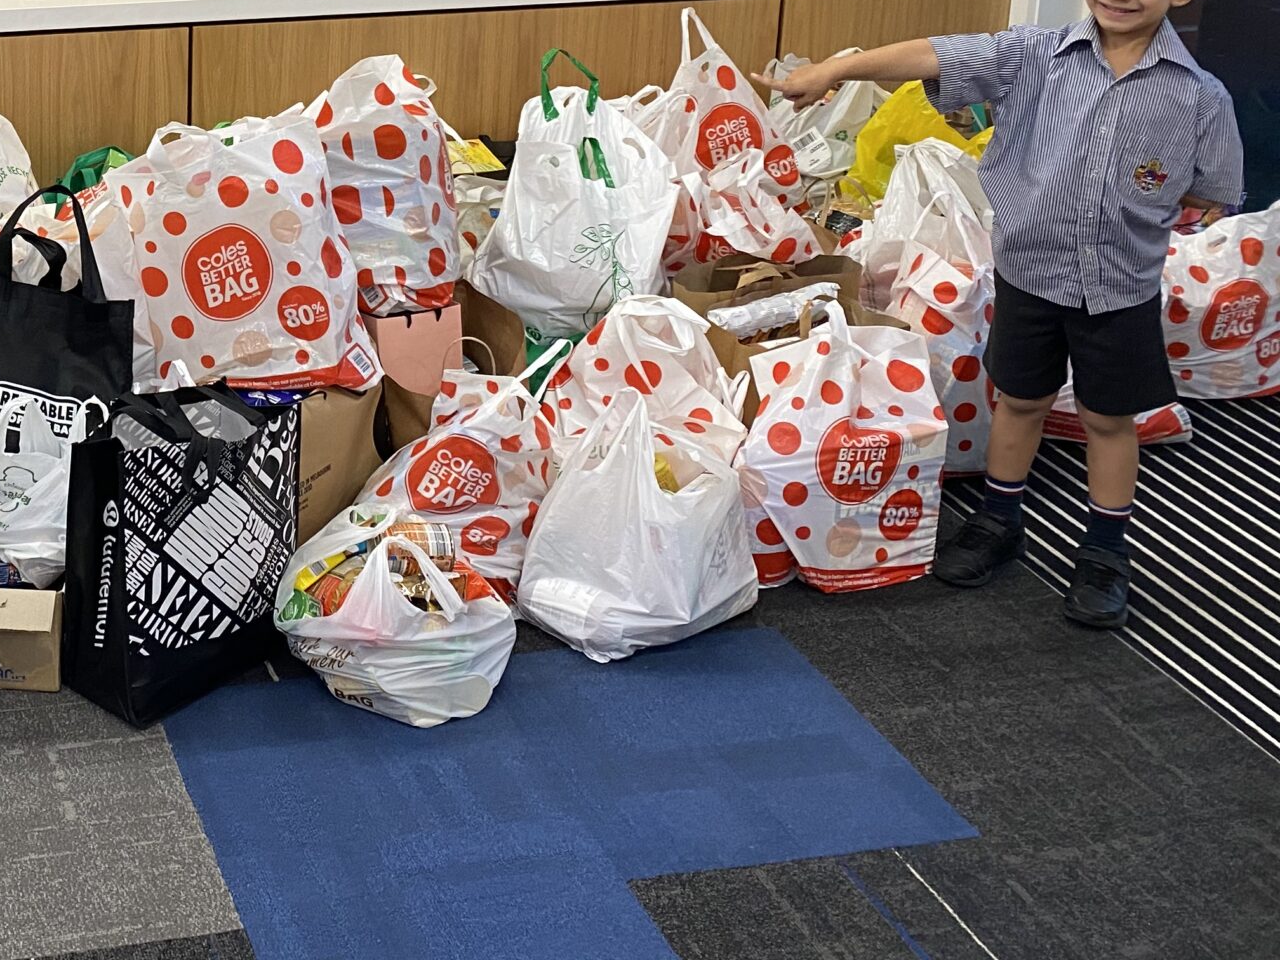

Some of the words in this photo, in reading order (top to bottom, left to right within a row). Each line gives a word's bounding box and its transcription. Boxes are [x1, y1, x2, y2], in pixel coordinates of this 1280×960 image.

[707, 116, 748, 140] coles
[708, 127, 751, 150] BETTER
[197, 240, 248, 271] coles
[200, 254, 252, 285] BETTER
[204, 268, 260, 308] BAG
[283, 301, 325, 328] 80%
[1211, 317, 1254, 340] BAG
[838, 448, 888, 462] BETTER
[428, 460, 485, 499] BETTER
[832, 461, 884, 486] BAG
[246, 509, 275, 548] GOALS
[882, 506, 920, 528] 80%
[136, 548, 160, 576] YOU
[201, 529, 267, 612] GOUS
[263, 546, 289, 598] HOPE
[334, 688, 374, 708] BAG
